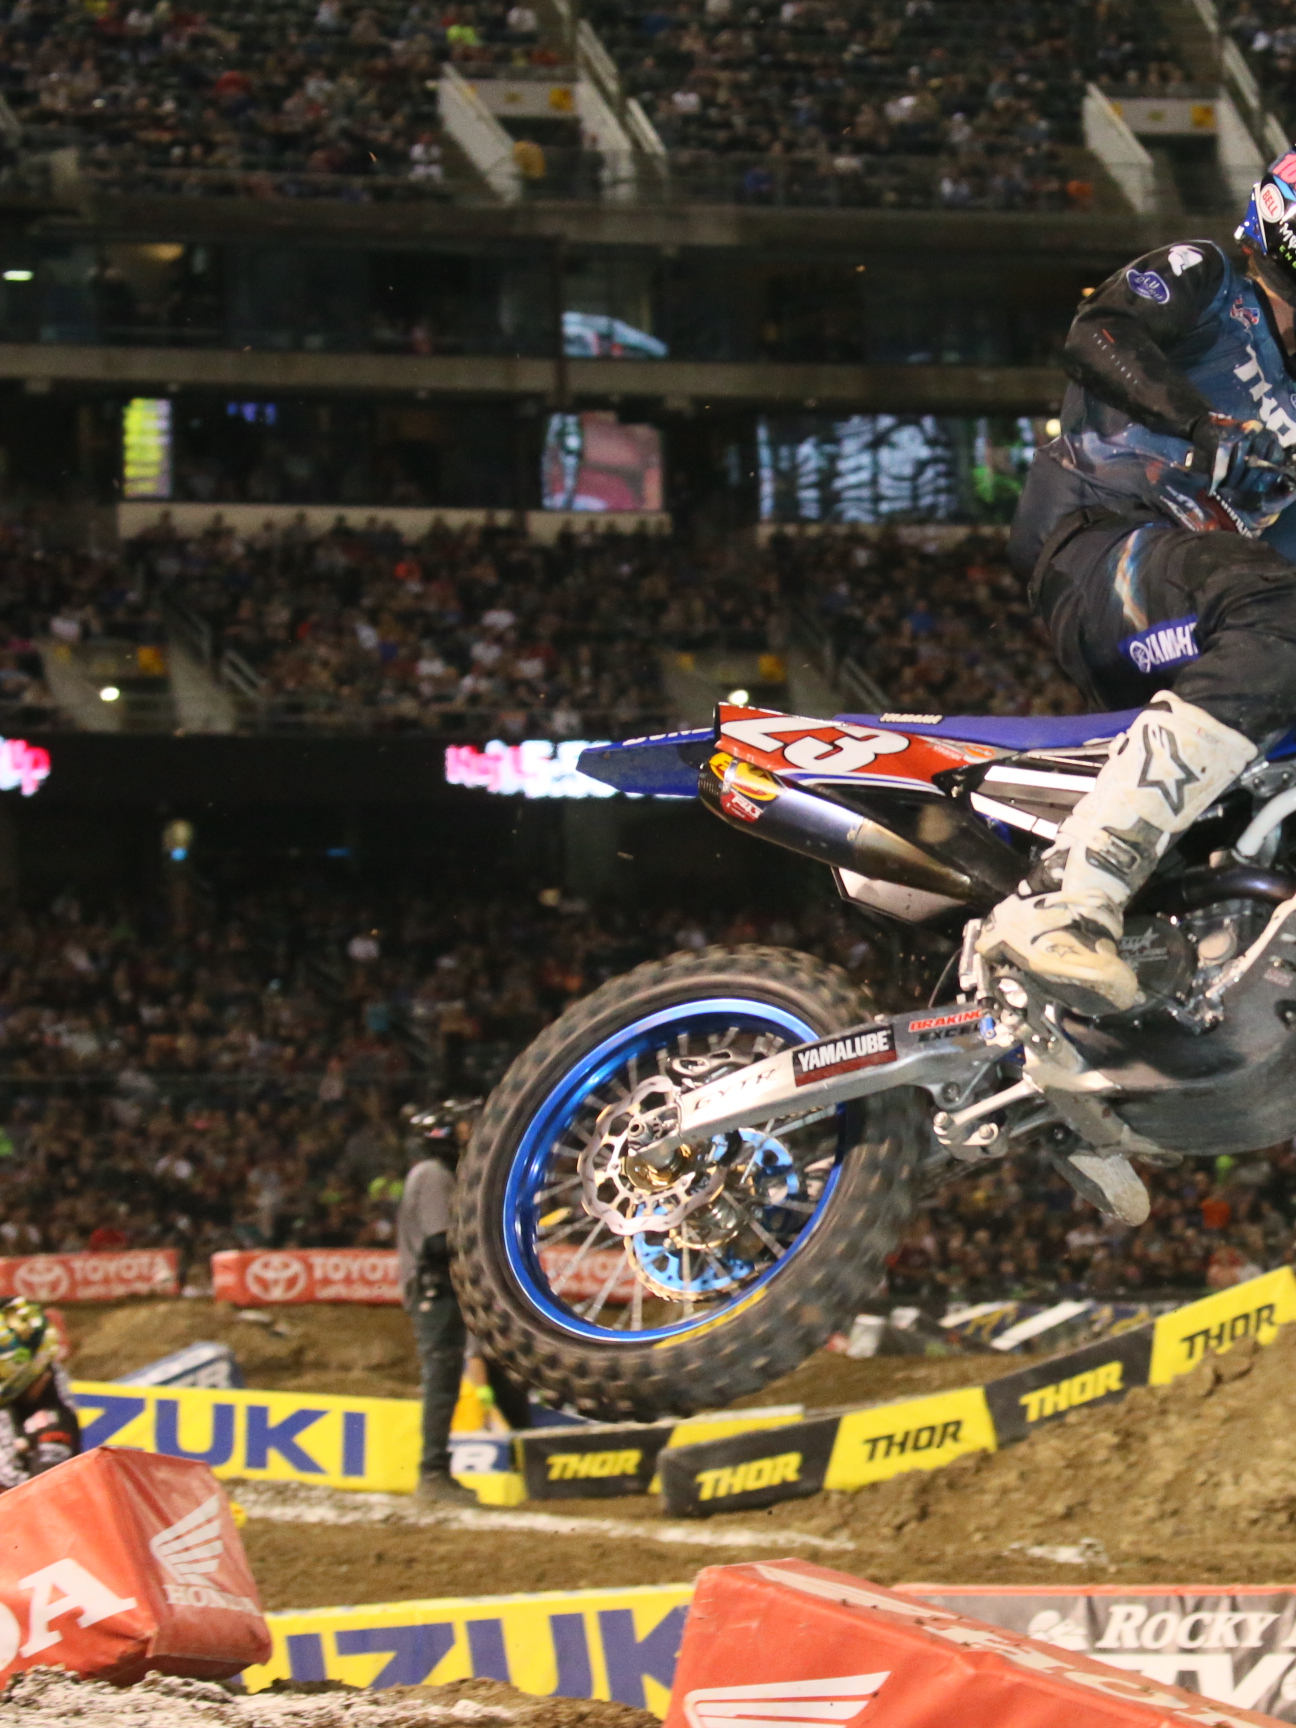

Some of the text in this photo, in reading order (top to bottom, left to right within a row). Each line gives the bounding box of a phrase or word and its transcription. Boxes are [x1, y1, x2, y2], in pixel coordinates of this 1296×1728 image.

[1261, 189, 1278, 217] BELL
[798, 1029, 891, 1073] YAMALUBE
[309, 1256, 399, 1281] TOYOT
[1181, 1304, 1277, 1359] THOR
[1019, 1360, 1124, 1422] THOR
[863, 1420, 963, 1462] THOR
[546, 1448, 643, 1481] THOR
[696, 1452, 803, 1500] THOR
[1098, 1603, 1282, 1650] ROCKY
